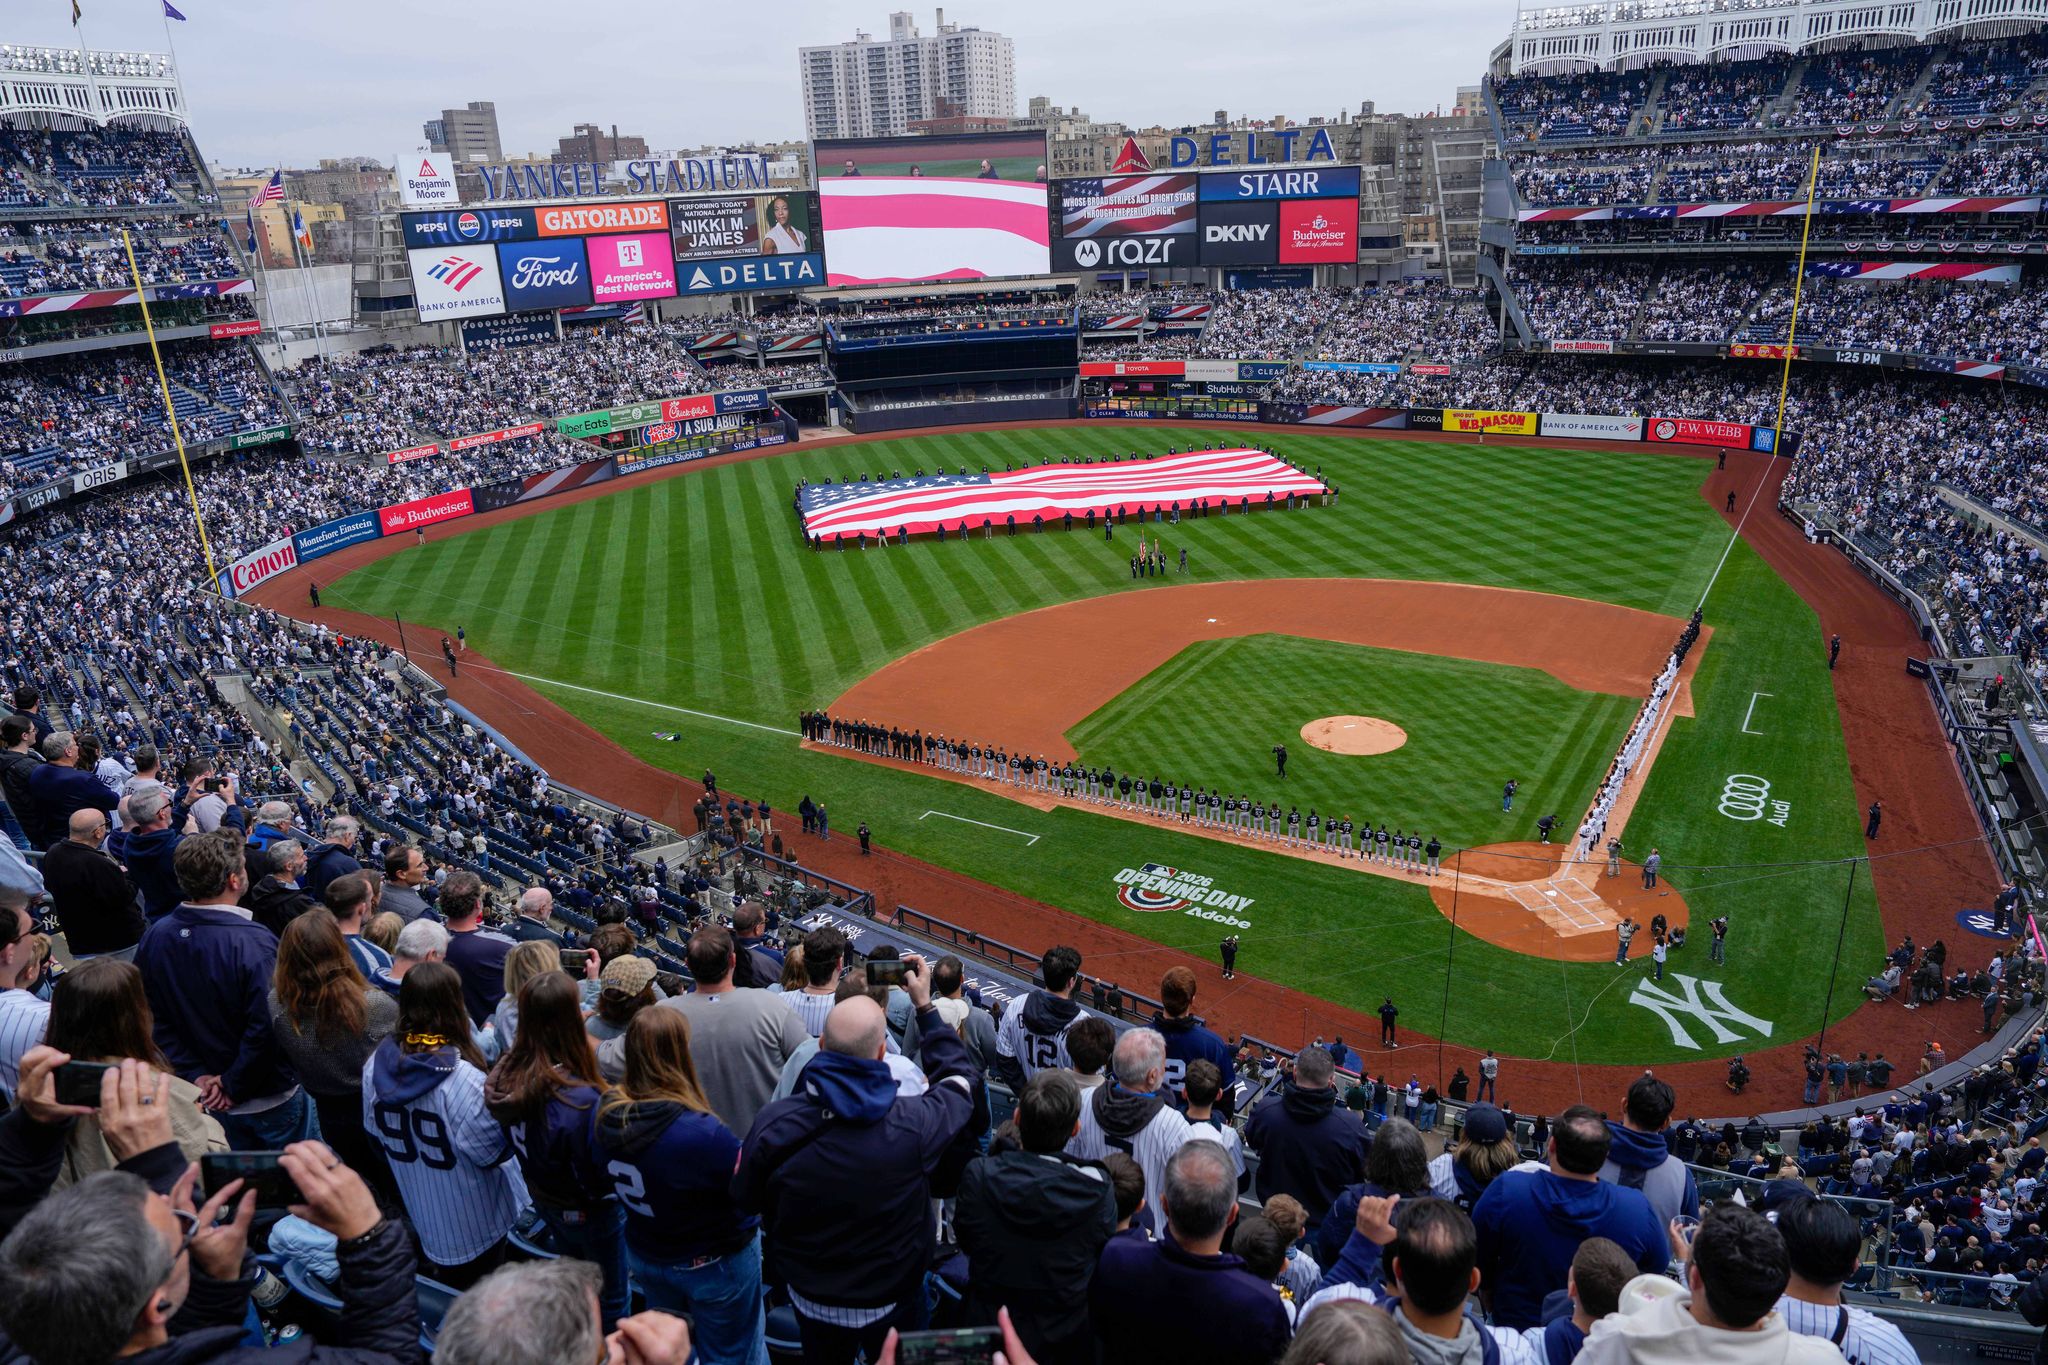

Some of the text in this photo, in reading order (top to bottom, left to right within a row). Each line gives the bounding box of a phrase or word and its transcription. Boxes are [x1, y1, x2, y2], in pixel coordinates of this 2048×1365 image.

[1171, 129, 1338, 168] DELTA
[408, 178, 451, 190] Benjamin
[479, 157, 769, 200] YANKEE STADIUM
[1238, 172, 1319, 196] STARR
[416, 189, 445, 199] Moore
[1063, 192, 1195, 207] WHOSE BROAD STRIPES AND BRIGHT STARS
[678, 203, 720, 211] PERFORMING
[684, 208, 743, 217] NATIONAL ANTHEM
[415, 222, 447, 232] PEPSI
[491, 219, 522, 228] PEPSI
[544, 205, 662, 231] GATORADE
[681, 217, 749, 234] NIKKI M.
[688, 231, 744, 248] JAMES
[1206, 224, 1271, 243] DKNY
[1293, 230, 1345, 240] Budweiser
[1108, 238, 1175, 264] razr
[1292, 240, 1311, 248] Made
[1317, 239, 1344, 247] America
[512, 256, 578, 289] Ford
[604, 270, 662, 284] America's
[720, 260, 815, 285] DELTA
[596, 280, 673, 295] Best Network
[420, 297, 501, 312] BANK OF AMERICA
[226, 324, 259, 335] Budweiser
[1554, 342, 1610, 351] Parts Authority
[1836, 350, 1881, 365] 1:25 PM
[1258, 367, 1285, 375] CLEAR
[1207, 384, 1243, 394] StubHub
[734, 393, 759, 404] coupa
[685, 413, 746, 435] A SUB ABOVE
[1238, 413, 1259, 421] StubHub
[1413, 415, 1441, 423] LEGORA
[1480, 414, 1525, 428] MASON
[560, 423, 583, 434] Uber
[584, 419, 609, 431] Eats
[1678, 422, 1742, 438] F.W. WEBB
[237, 429, 285, 447] Poland Spring
[620, 462, 646, 475] StubHub
[647, 456, 673, 468] StubHub
[675, 450, 703, 462] StubHub
[734, 440, 756, 451] STARR
[83, 467, 117, 488] ORIS
[27, 487, 60, 509] 1:25 PM
[407, 500, 468, 522] Budweiser
[299, 519, 373, 549] Montefiore Einstein
[233, 545, 295, 590] Canon
[1767, 800, 1791, 827] Audi
[1175, 871, 1214, 887] 2026
[1112, 868, 1255, 912] OPENING DAY
[1185, 907, 1251, 929] Adobe
[1629, 972, 1773, 1050] NY
[1024, 1034, 1058, 1069] 12
[374, 1100, 457, 1171] 99
[607, 1159, 655, 1218] 2
